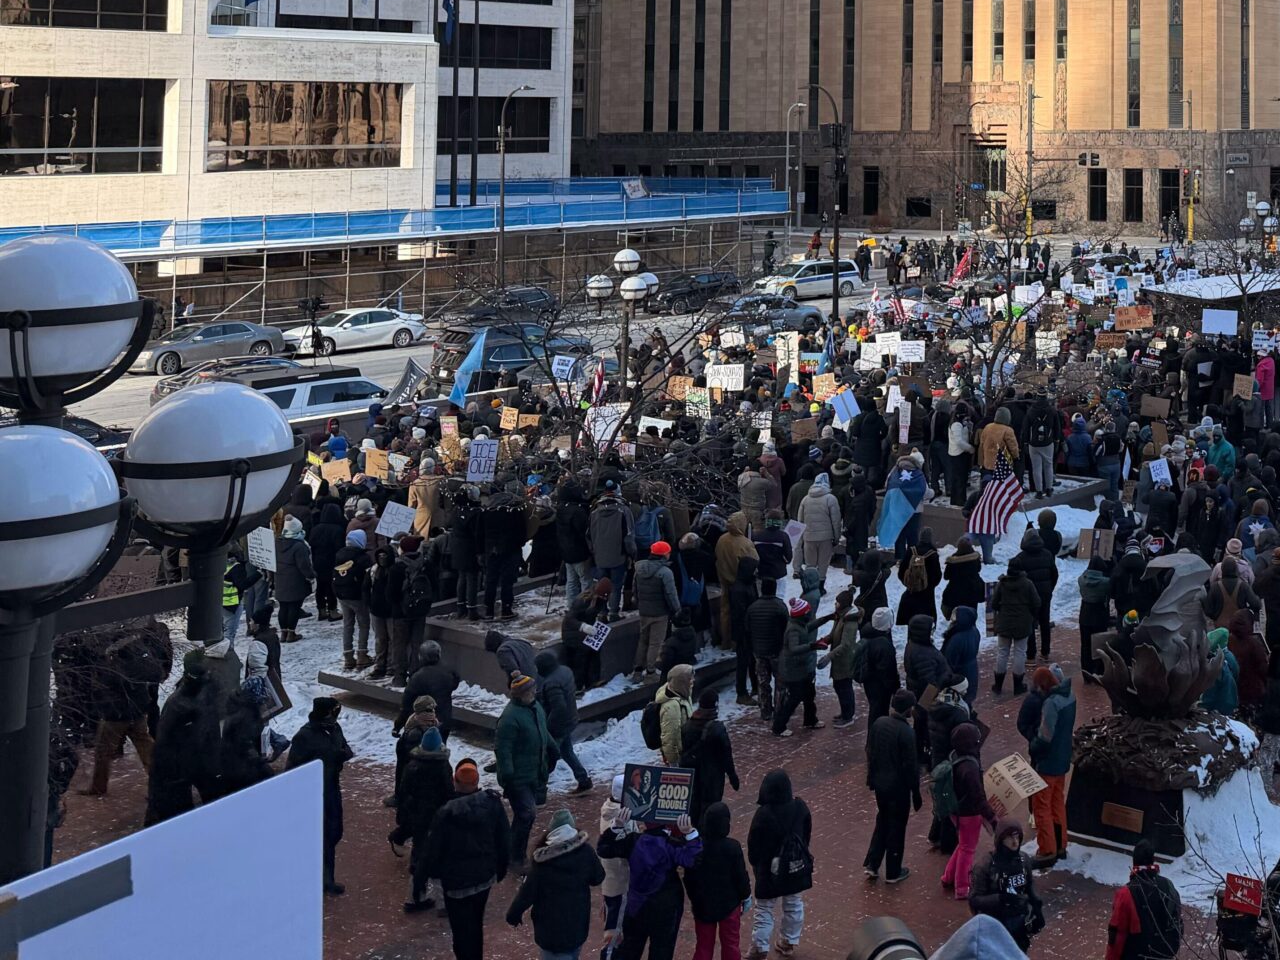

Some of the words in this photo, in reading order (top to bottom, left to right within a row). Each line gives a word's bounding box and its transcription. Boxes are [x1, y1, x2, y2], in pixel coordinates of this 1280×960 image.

[1146, 347, 1161, 356] ICE
[474, 443, 497, 459] ICE
[470, 459, 494, 474] OUT
[594, 622, 609, 633] ICE
[988, 767, 1005, 786] ICE
[1003, 756, 1018, 772] The
[1012, 768, 1040, 794] WRONG
[658, 784, 689, 800] GOOD
[657, 799, 688, 810] TROUBLE
